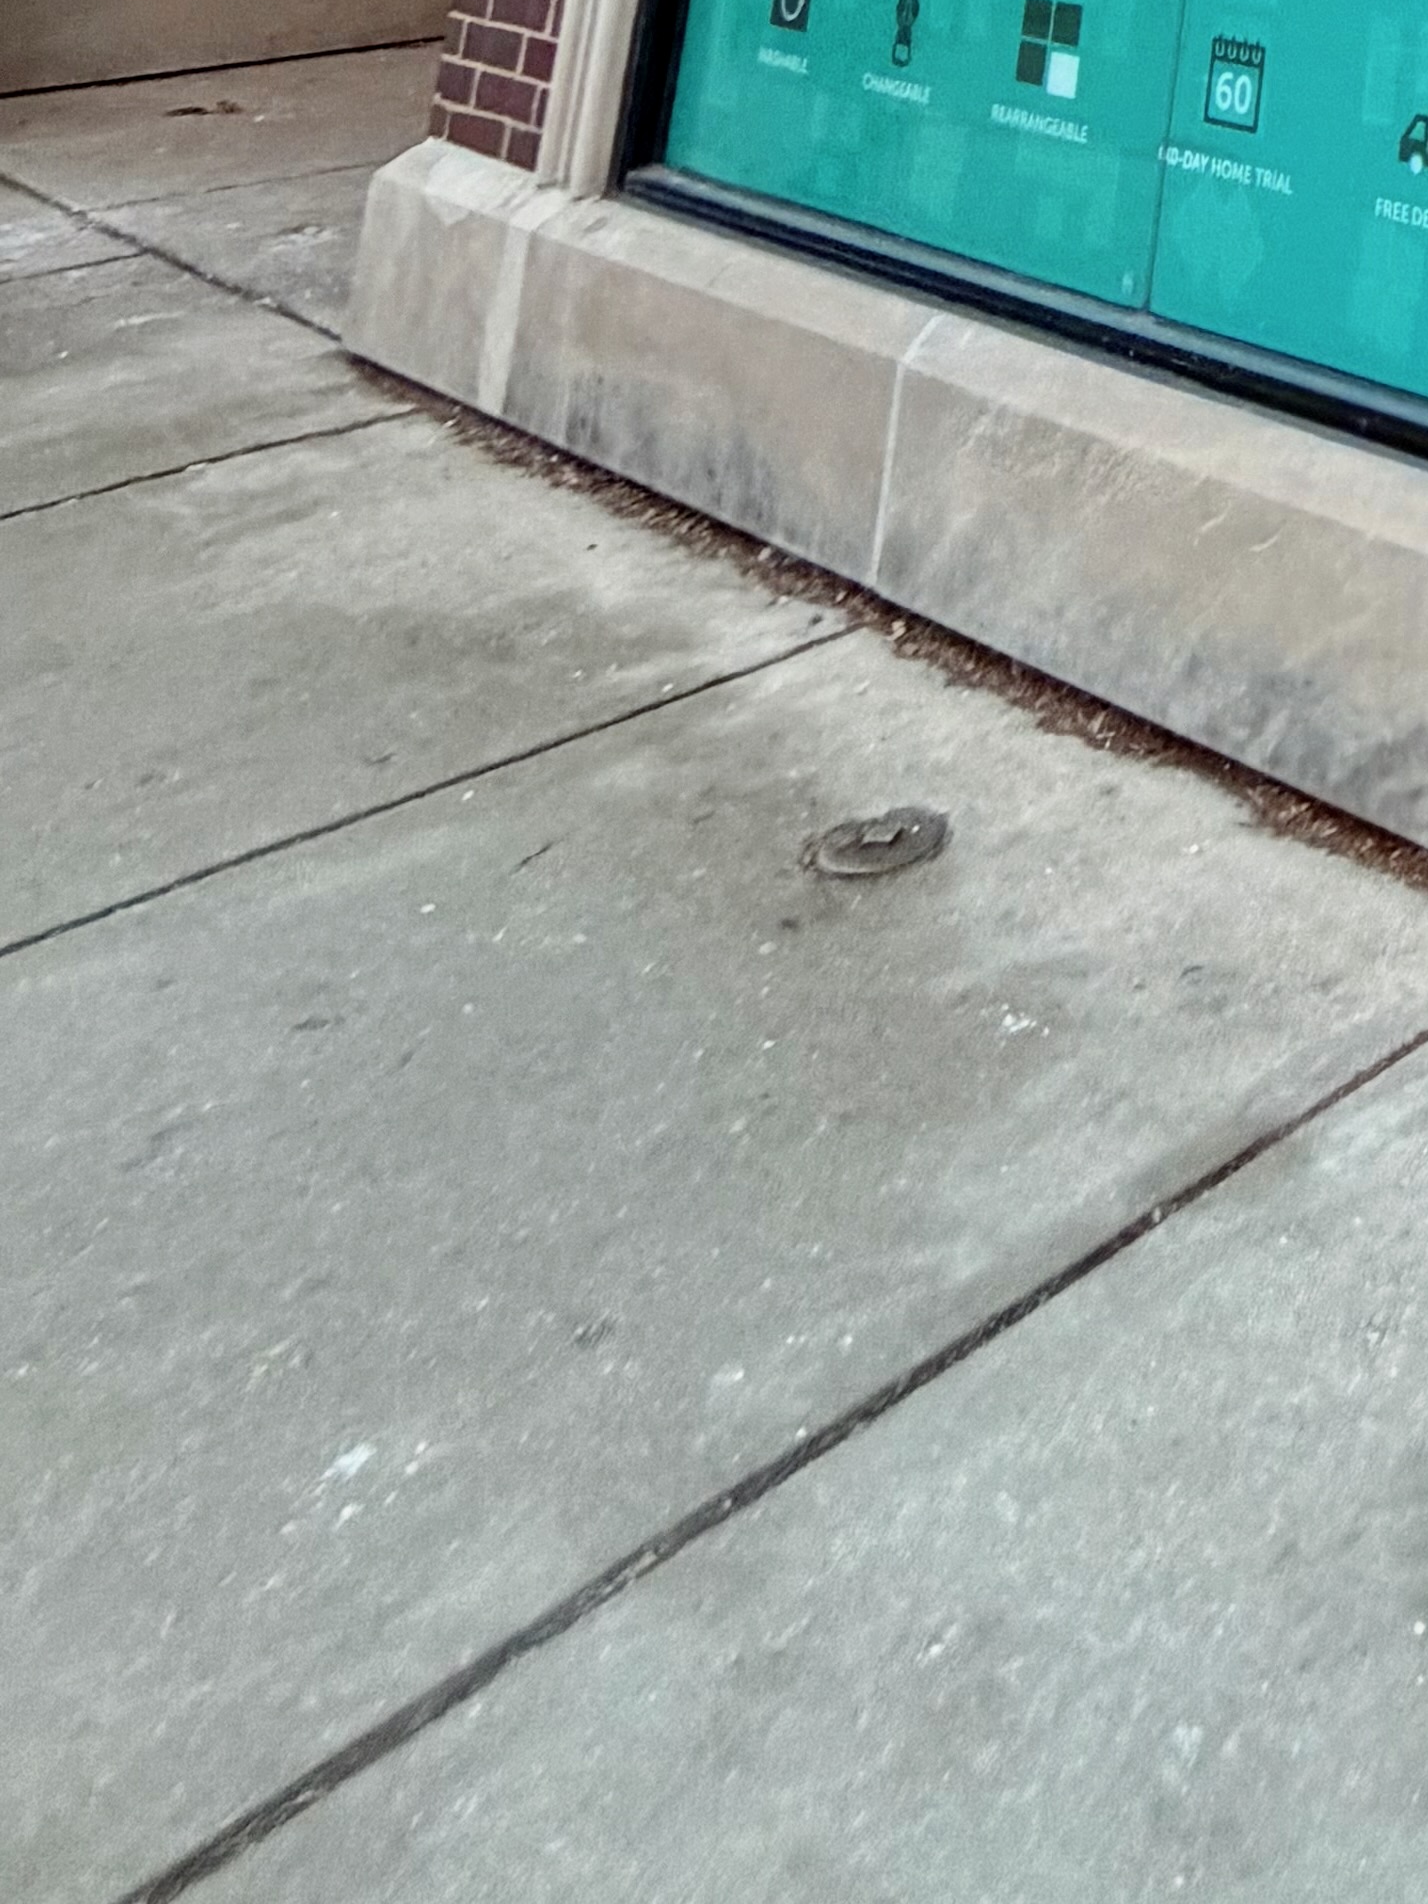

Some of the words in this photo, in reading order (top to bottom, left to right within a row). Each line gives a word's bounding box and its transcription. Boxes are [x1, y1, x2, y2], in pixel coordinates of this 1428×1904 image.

[1215, 72, 1252, 114] 60
[1211, 156, 1253, 185] HOME
[1255, 167, 1293, 195] TRIAL
[1375, 196, 1410, 224] FREE
